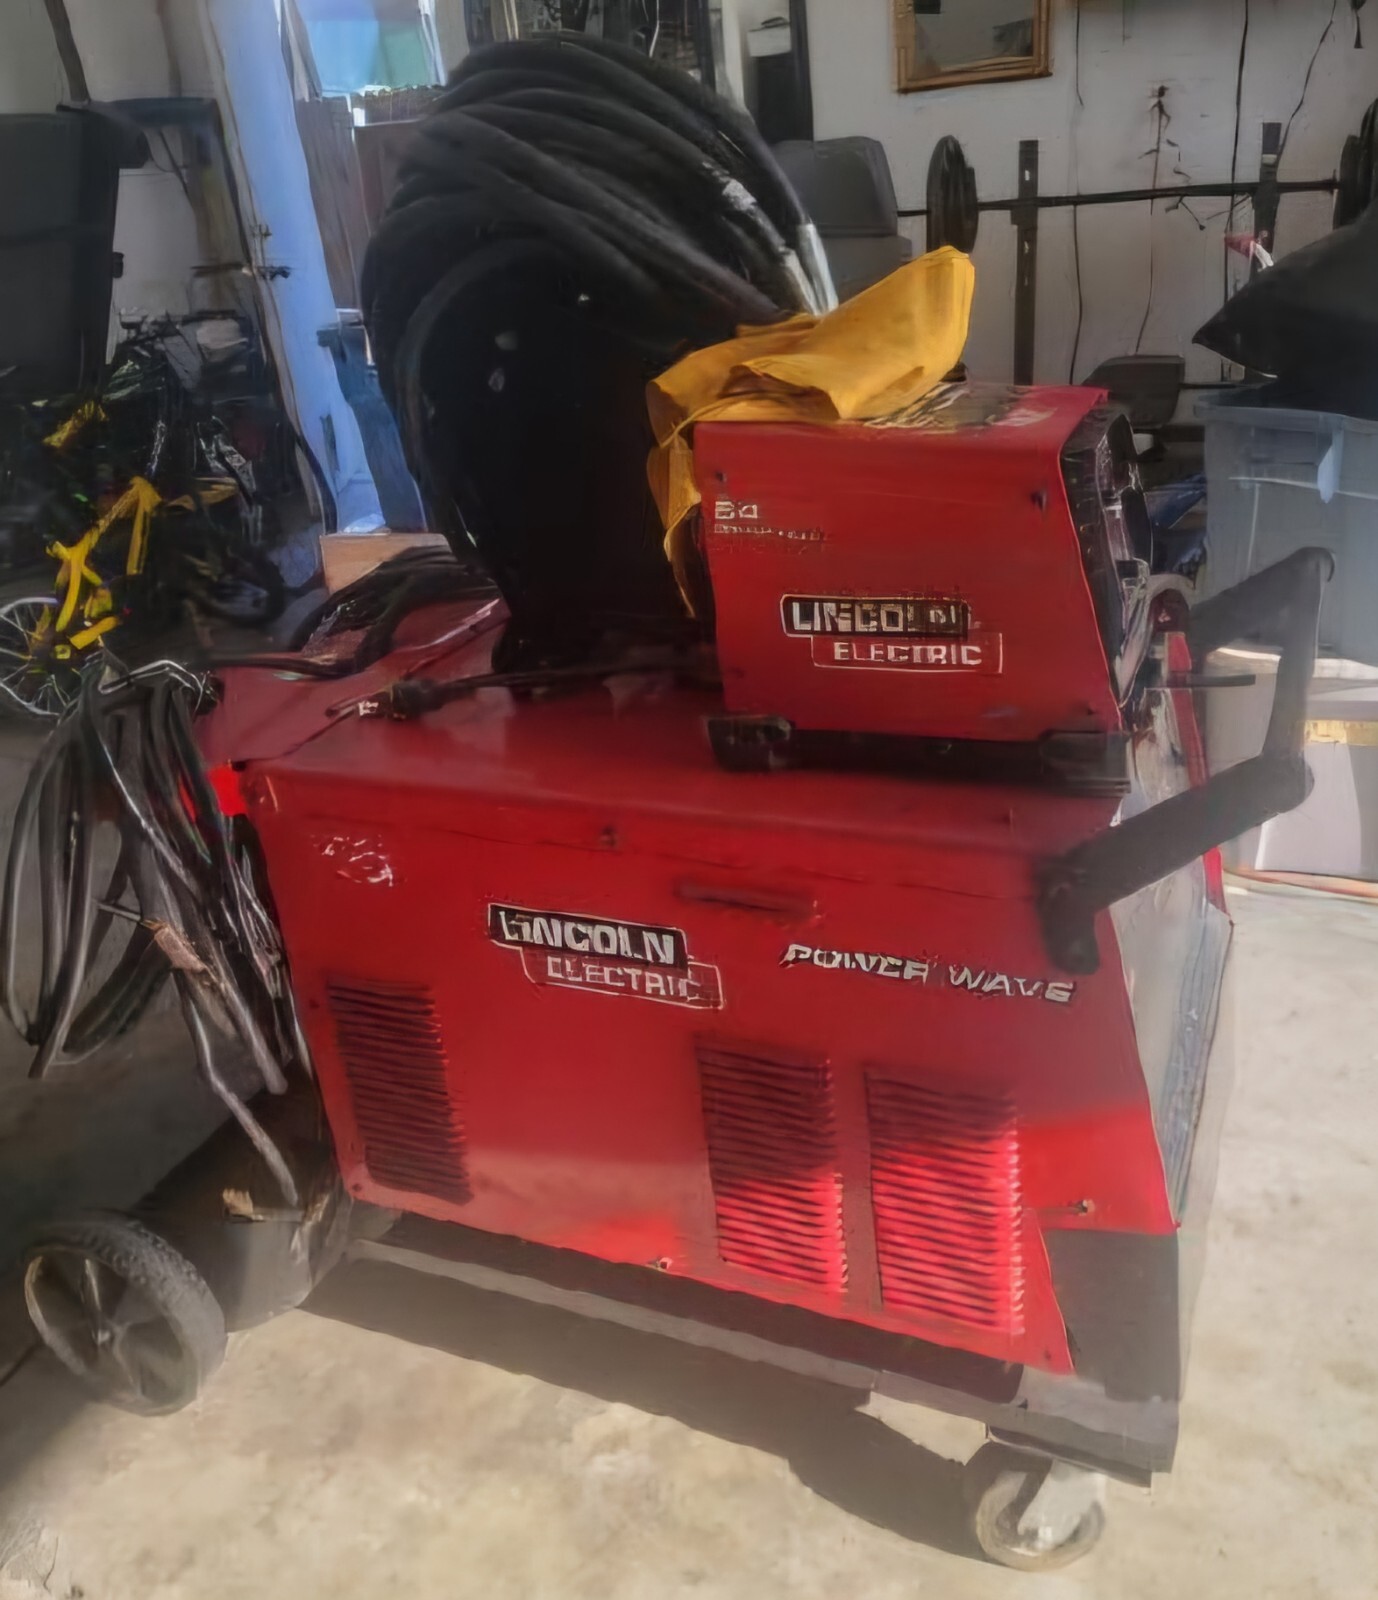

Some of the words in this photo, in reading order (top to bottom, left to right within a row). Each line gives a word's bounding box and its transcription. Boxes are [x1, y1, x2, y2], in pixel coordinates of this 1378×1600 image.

[833, 641, 983, 666] ELECTRIC
[498, 910, 675, 965] LINCOLN
[547, 955, 701, 1001] ELECTRIC
[780, 943, 929, 984] POWER
[948, 964, 1075, 1003] WAVE
